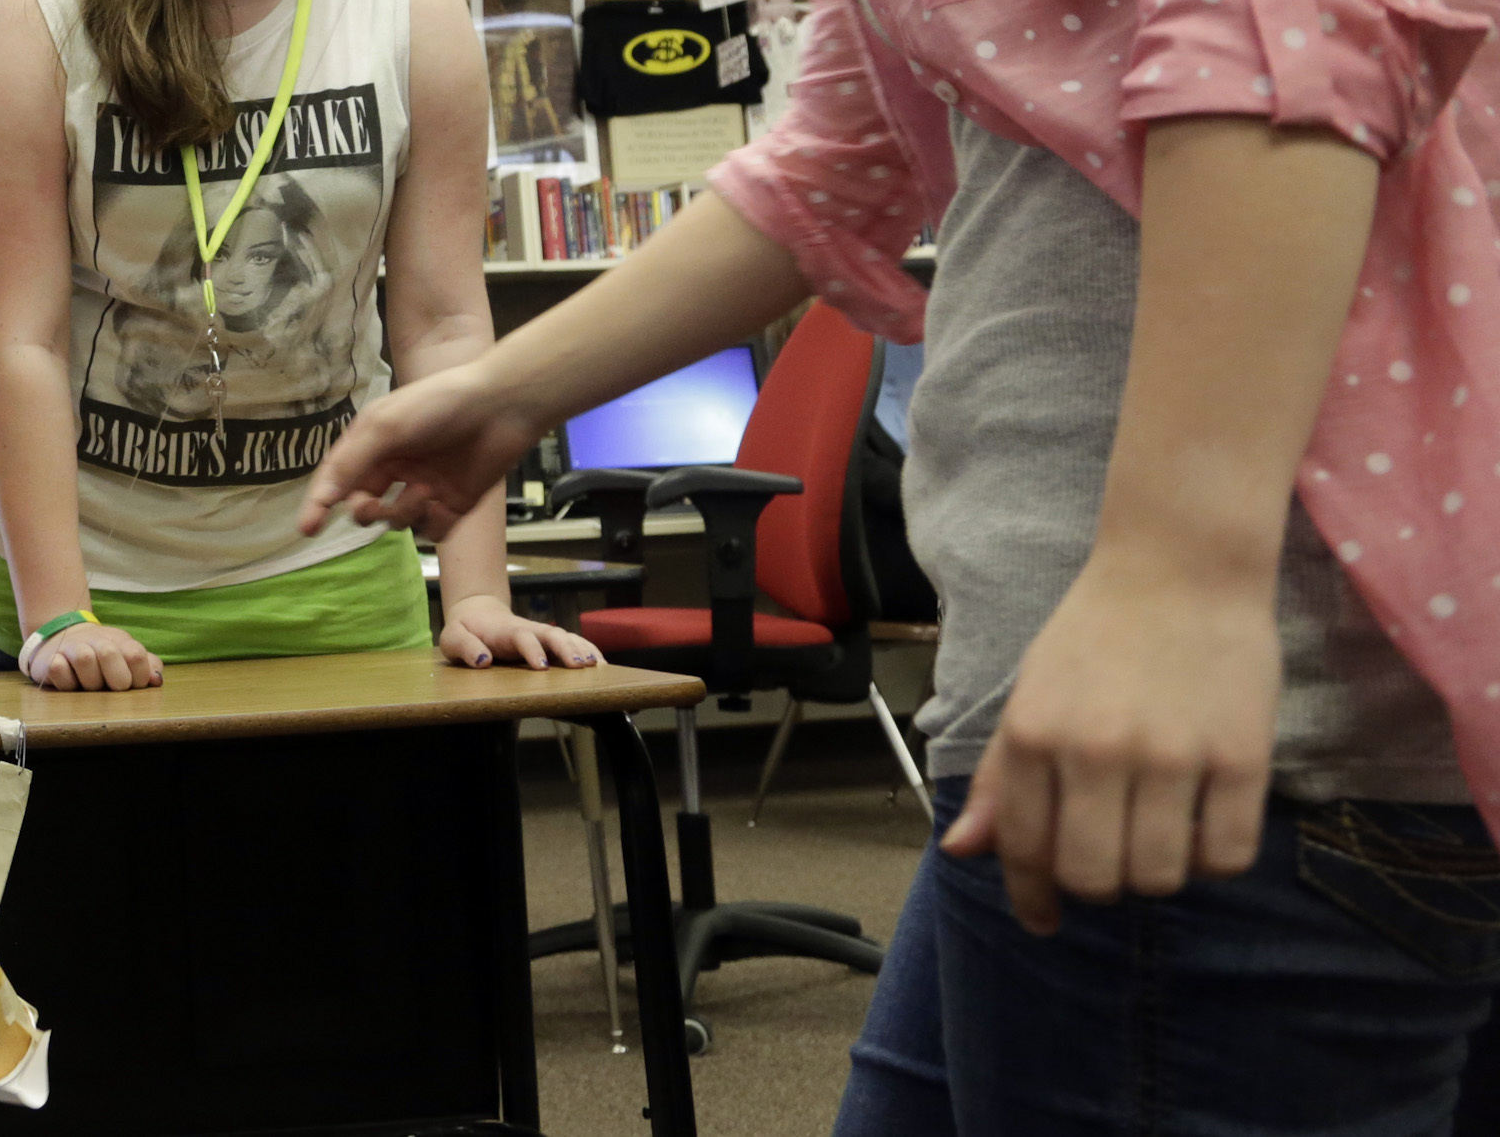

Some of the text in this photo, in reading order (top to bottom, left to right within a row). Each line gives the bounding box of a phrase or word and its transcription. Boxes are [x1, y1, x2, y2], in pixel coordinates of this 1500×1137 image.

[234, 109, 273, 168] SO
[285, 96, 372, 161] FAKE
[84, 412, 228, 478] BARBIE'S
